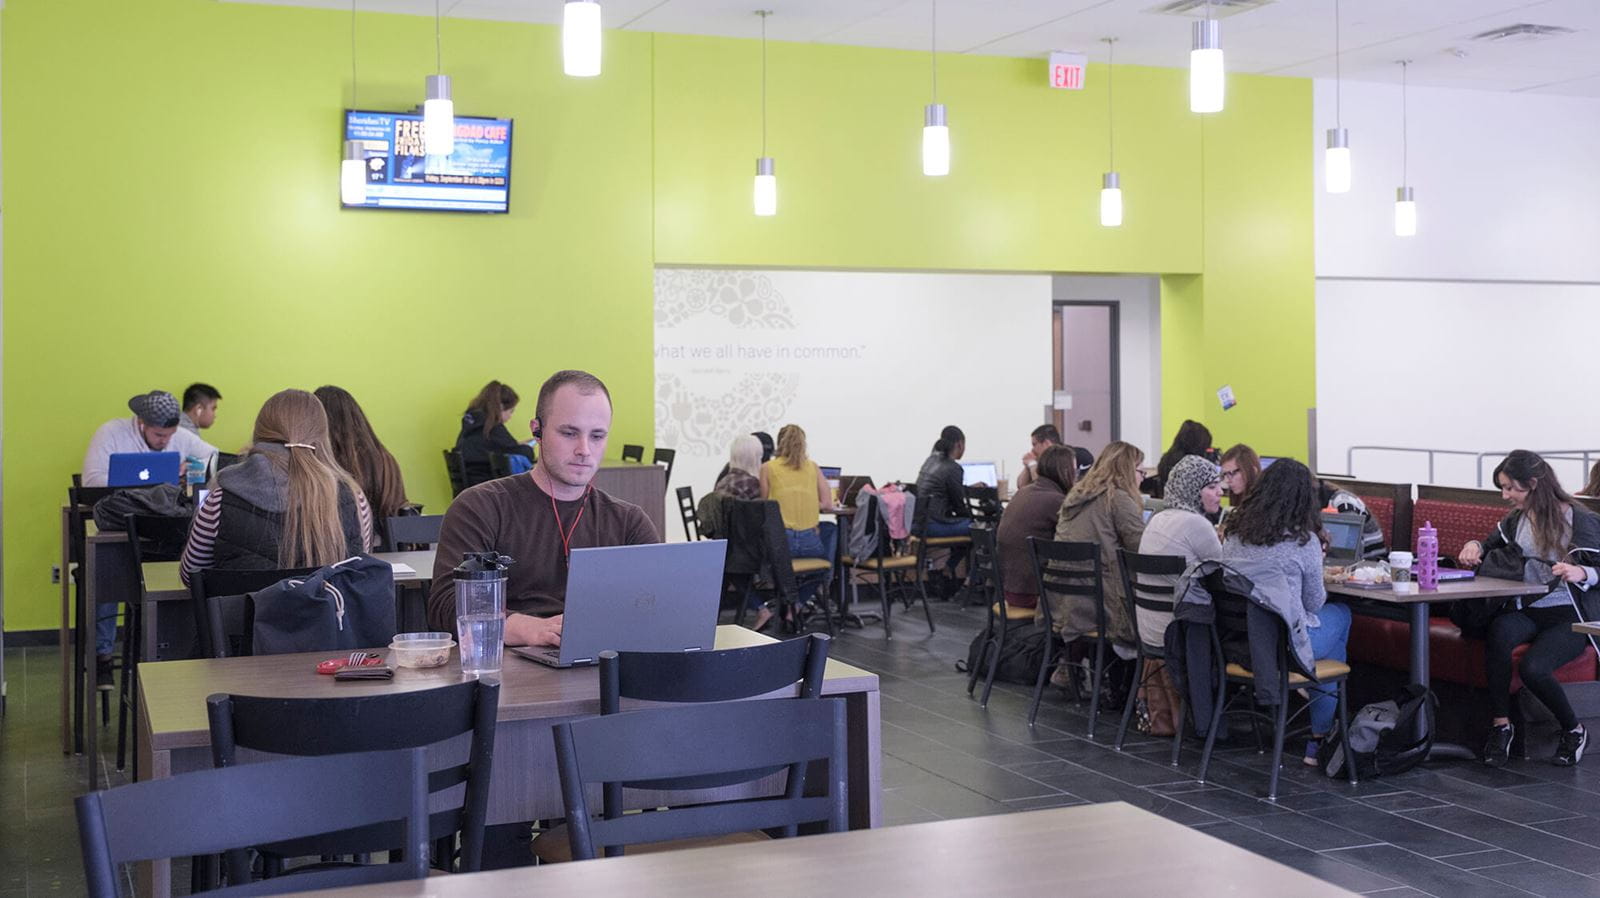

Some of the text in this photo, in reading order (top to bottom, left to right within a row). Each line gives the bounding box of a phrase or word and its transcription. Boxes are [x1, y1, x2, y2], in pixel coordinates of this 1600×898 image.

[1054, 65, 1081, 88] EXIT
[395, 145, 426, 156] FILMS
[691, 347, 711, 359] we
[716, 344, 733, 359] all
[737, 344, 773, 359] have
[776, 344, 790, 359] in
